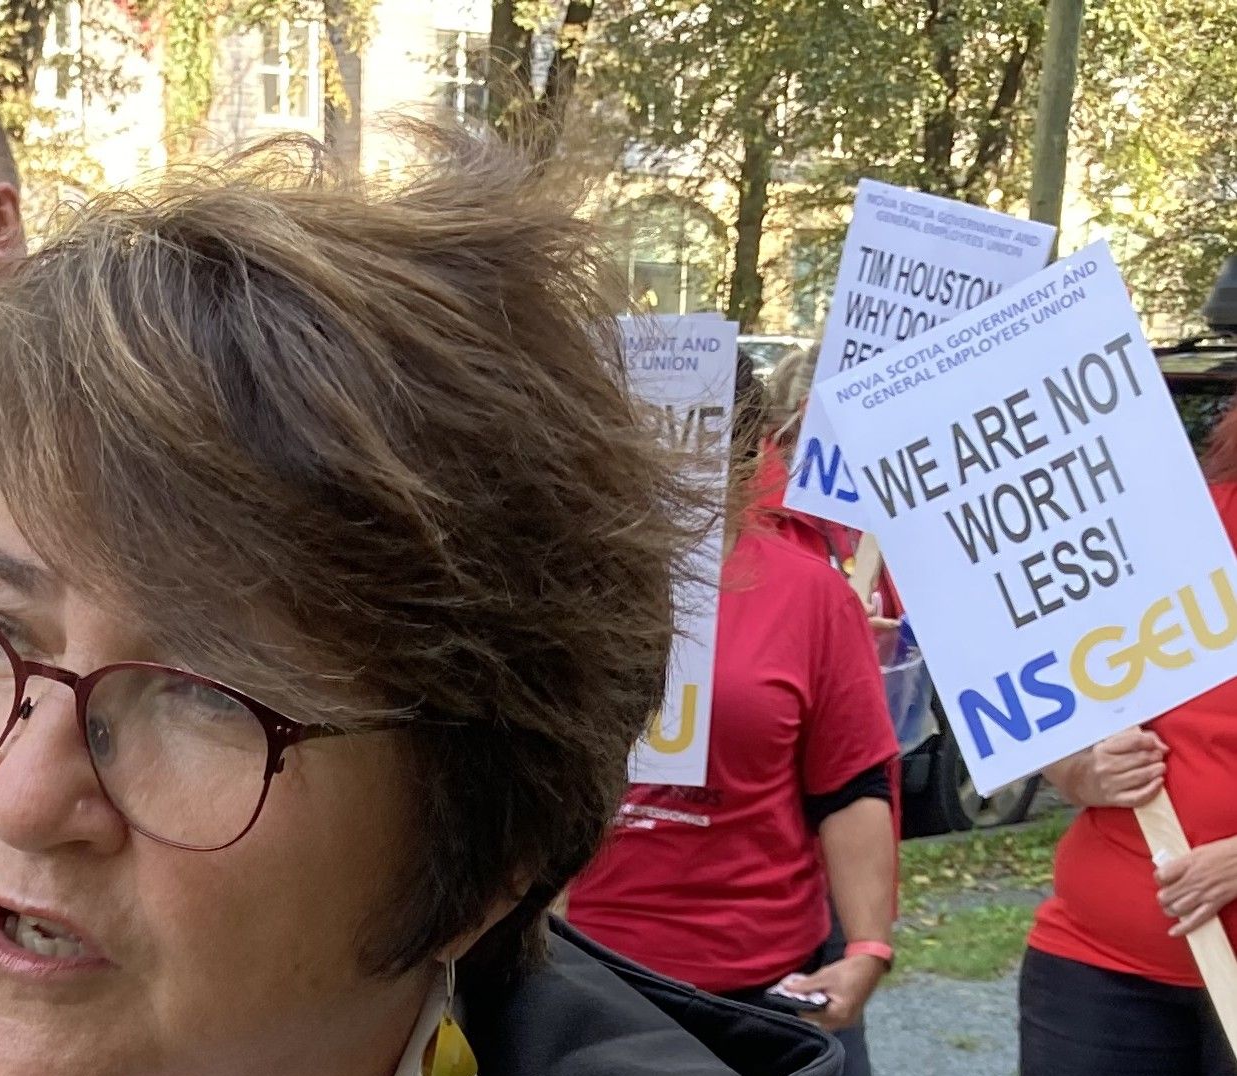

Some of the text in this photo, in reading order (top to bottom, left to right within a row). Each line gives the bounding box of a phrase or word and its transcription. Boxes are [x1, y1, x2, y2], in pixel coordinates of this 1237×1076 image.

[845, 291, 897, 336] WHY
[856, 246, 894, 290] TIM
[642, 356, 699, 371] UNION
[682, 337, 721, 353] AND
[836, 372, 886, 404] NOVA
[886, 343, 945, 380] SCOTIA
[946, 282, 1058, 349] GOVERNMENT
[1063, 260, 1098, 288] AND
[861, 287, 1086, 409] GENERAL EMPLOYEES UNION
[862, 437, 948, 519] WE
[950, 388, 1049, 485] ARE
[1043, 332, 1143, 435] NOT
[943, 435, 1125, 564] WORTH
[995, 518, 1134, 629] LESS!
[958, 567, 1237, 760] NSGEU
